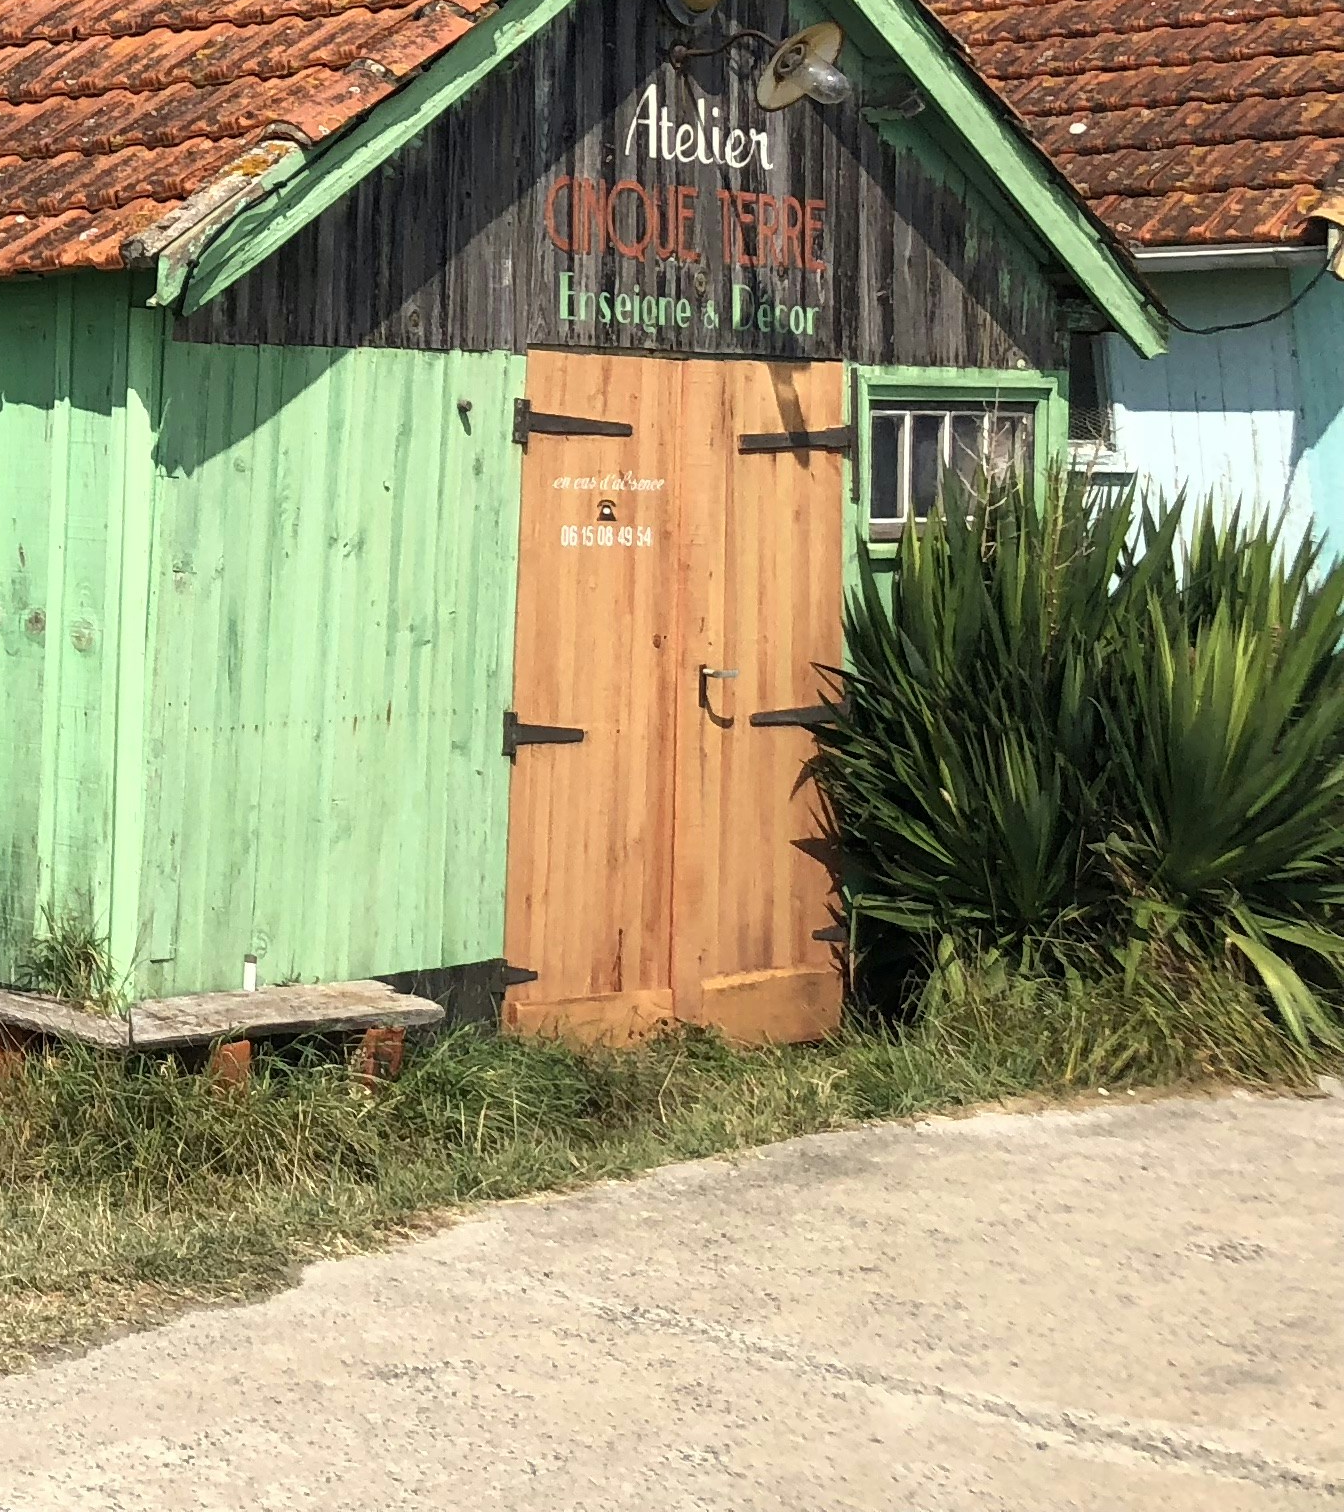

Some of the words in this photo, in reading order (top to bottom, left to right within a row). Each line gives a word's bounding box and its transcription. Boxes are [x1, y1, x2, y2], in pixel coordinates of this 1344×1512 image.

[625, 83, 774, 170] Atelier
[544, 175, 701, 264] CINQUE
[716, 189, 827, 273] TERRE
[559, 271, 692, 335] Enseigne
[703, 299, 719, 330] &
[732, 284, 821, 336] Décor
[552, 476, 572, 490] en
[573, 476, 597, 491] cas
[560, 525, 578, 547] 06
[581, 525, 595, 547] 15
[597, 525, 614, 547] 08
[617, 525, 633, 548] 49
[636, 525, 653, 548] 54
